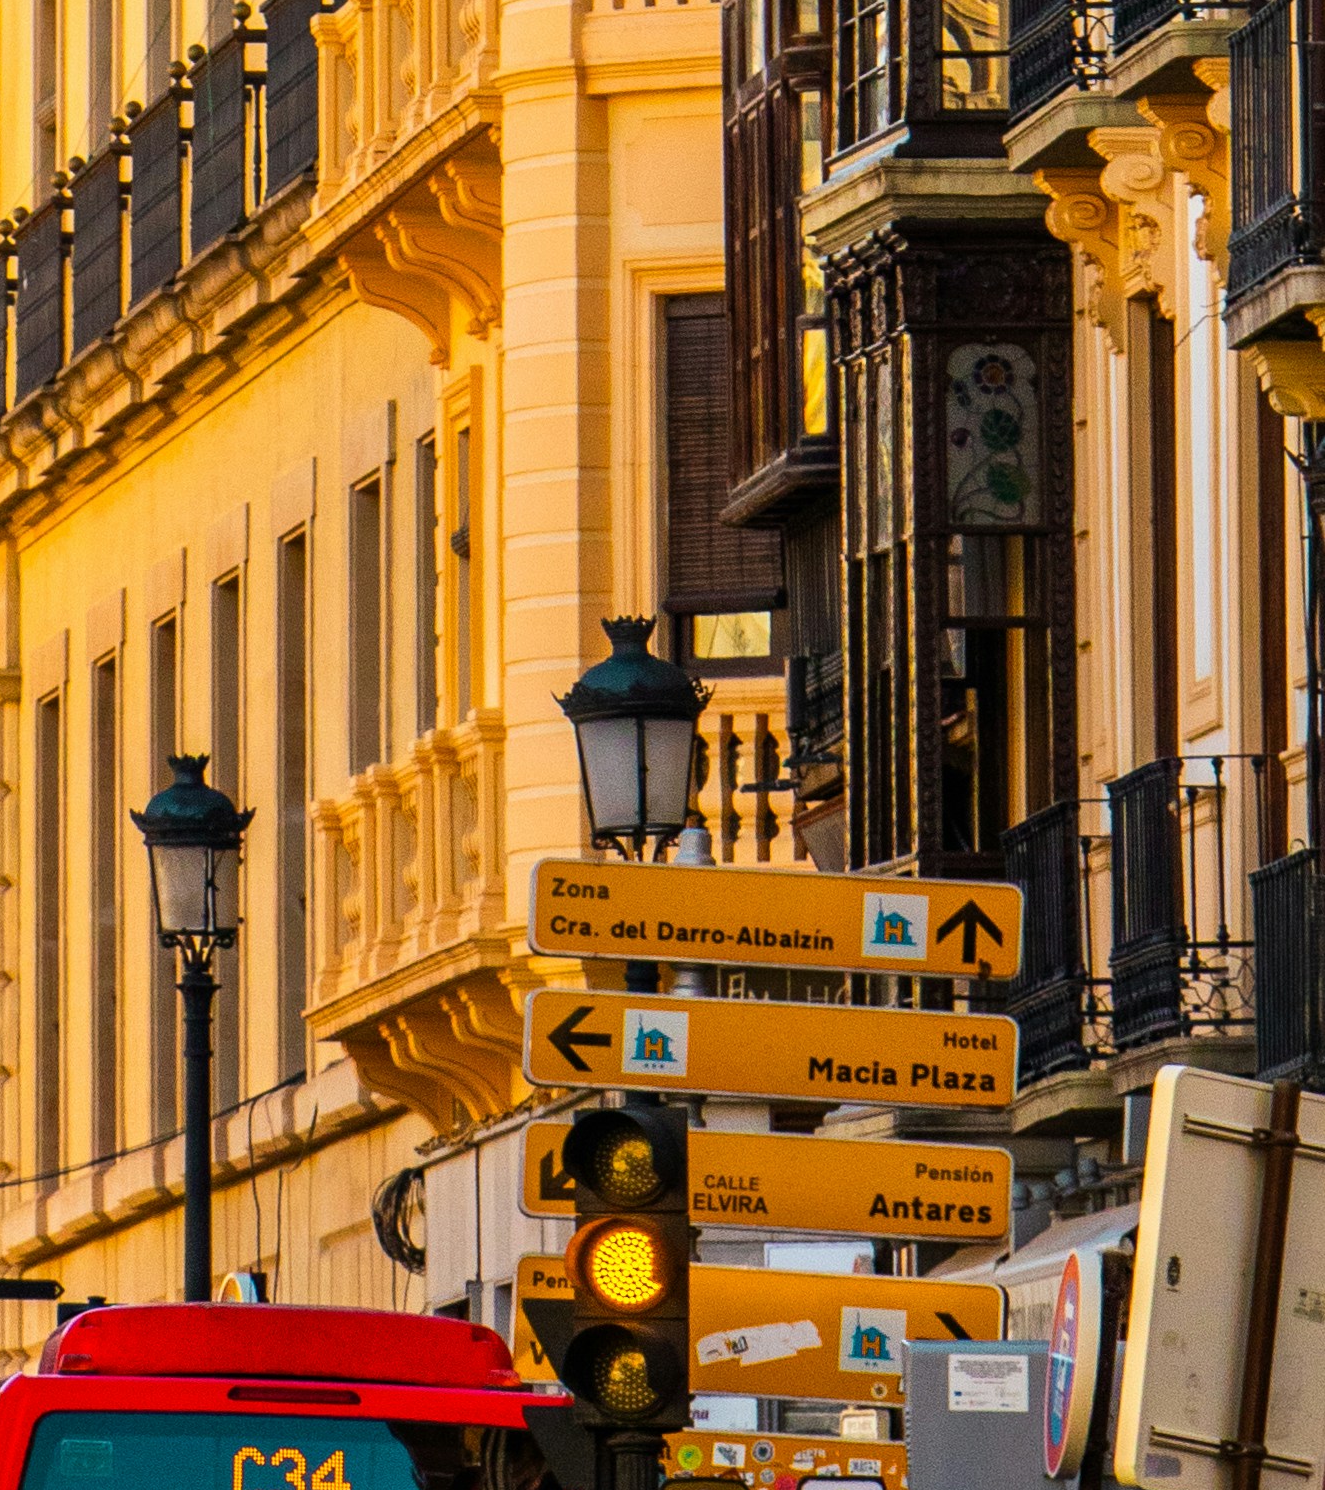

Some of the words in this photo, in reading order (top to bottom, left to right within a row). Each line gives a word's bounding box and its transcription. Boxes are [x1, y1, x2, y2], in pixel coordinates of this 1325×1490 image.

[552, 878, 610, 900] Zona
[550, 916, 599, 937] Cra.
[611, 920, 647, 940] del
[943, 1032, 998, 1051] Hotel
[808, 1056, 898, 1086] Macia
[910, 1063, 996, 1092] Plaza
[703, 1174, 759, 1191] CALLE
[915, 1162, 994, 1183] Pensión
[692, 1192, 769, 1214] ELVIRA
[868, 1193, 993, 1224] Antares
